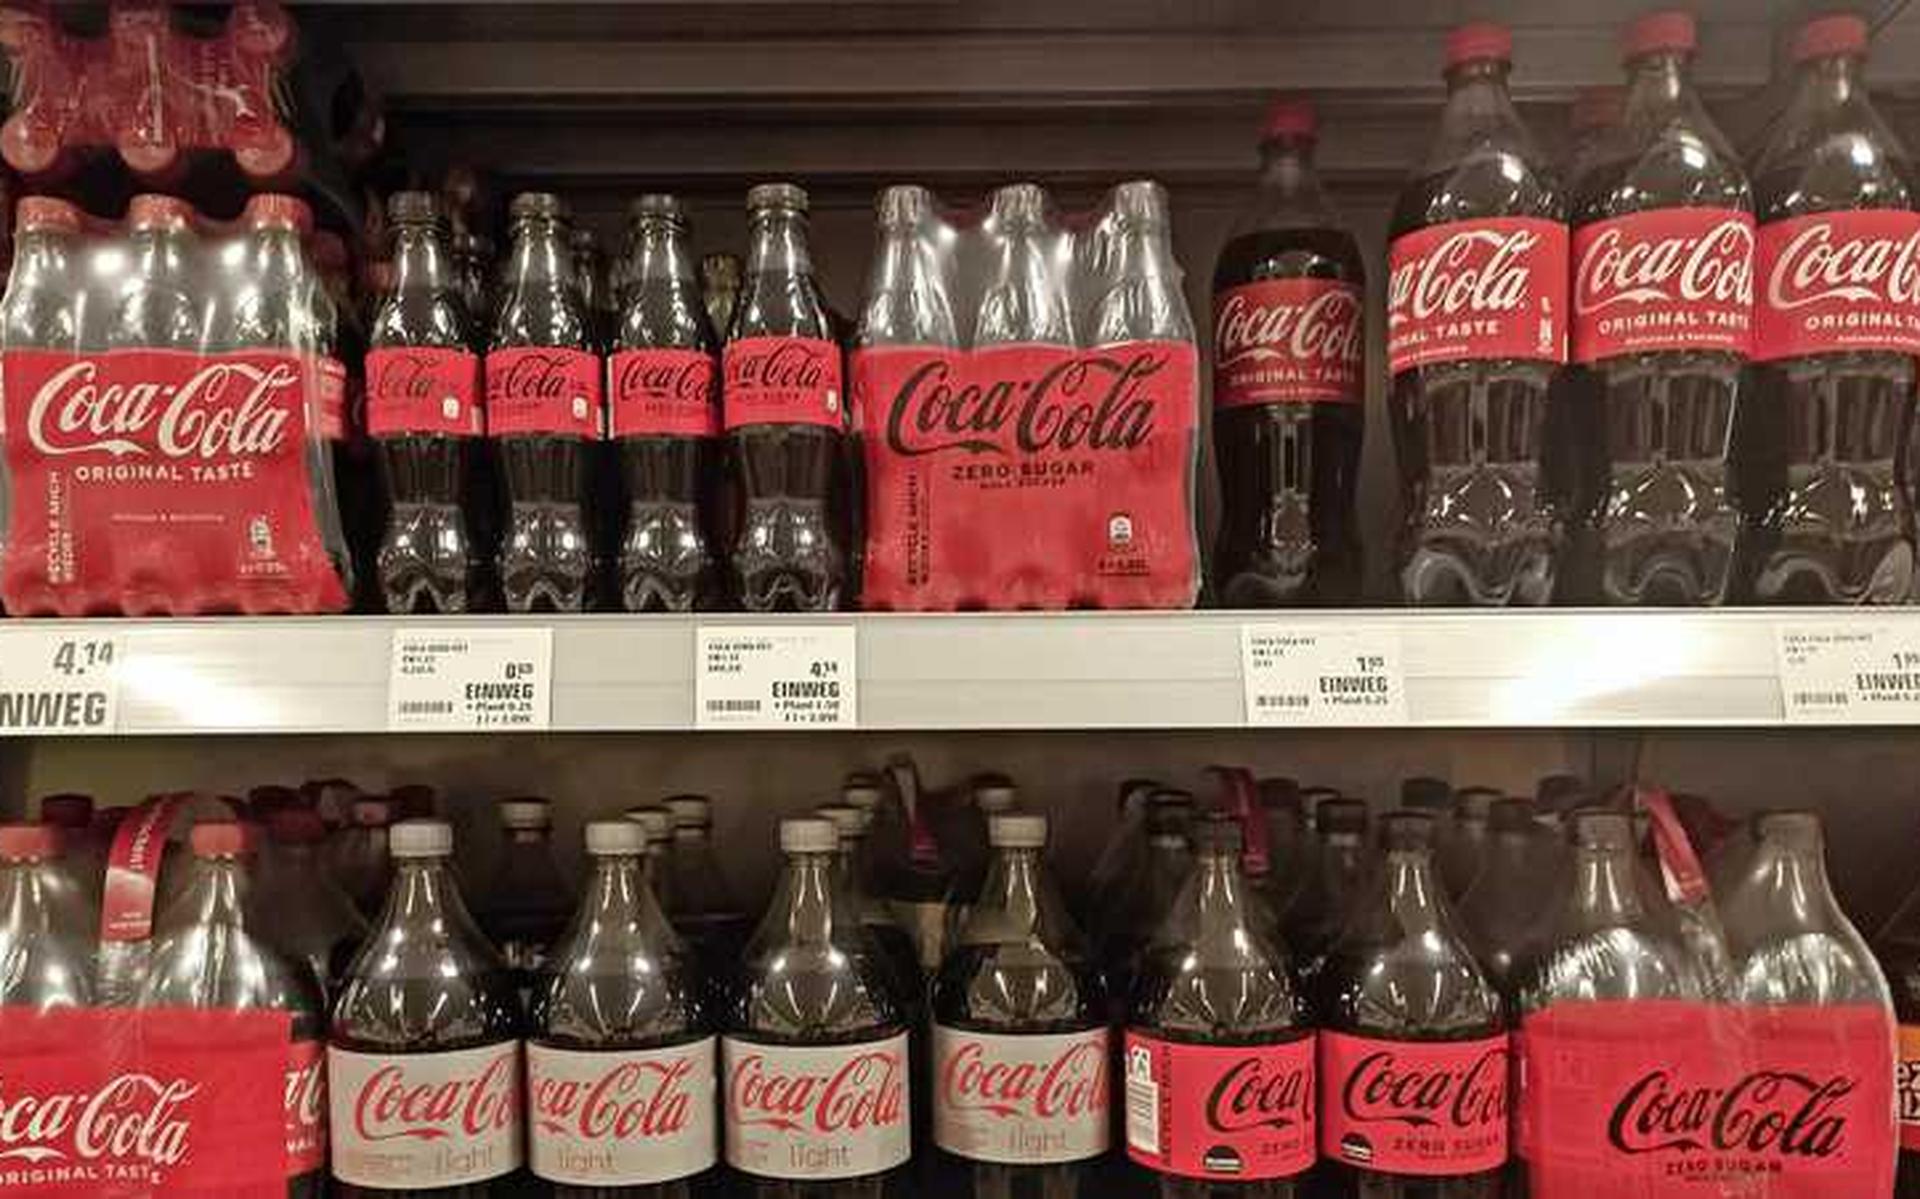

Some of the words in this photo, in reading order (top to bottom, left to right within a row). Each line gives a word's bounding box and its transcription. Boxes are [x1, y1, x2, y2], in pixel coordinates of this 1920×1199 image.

[1436, 319, 1499, 339] TASTE
[1599, 311, 1699, 335] ORIGINAL
[1805, 311, 1901, 330] ORIGINAL
[28, 361, 298, 458] Coca-Cola
[887, 353, 1171, 457] Coca-Cola
[75, 464, 184, 482] ORIGINAL
[190, 462, 254, 481] TASTE
[953, 465, 1011, 481] ZERO
[1021, 460, 1096, 478] SUGAR
[465, 682, 534, 700] EINWEG
[772, 681, 840, 699] EINWEG
[1319, 676, 1388, 694] EINWEG
[1607, 1070, 1855, 1158] Coca-Cola
